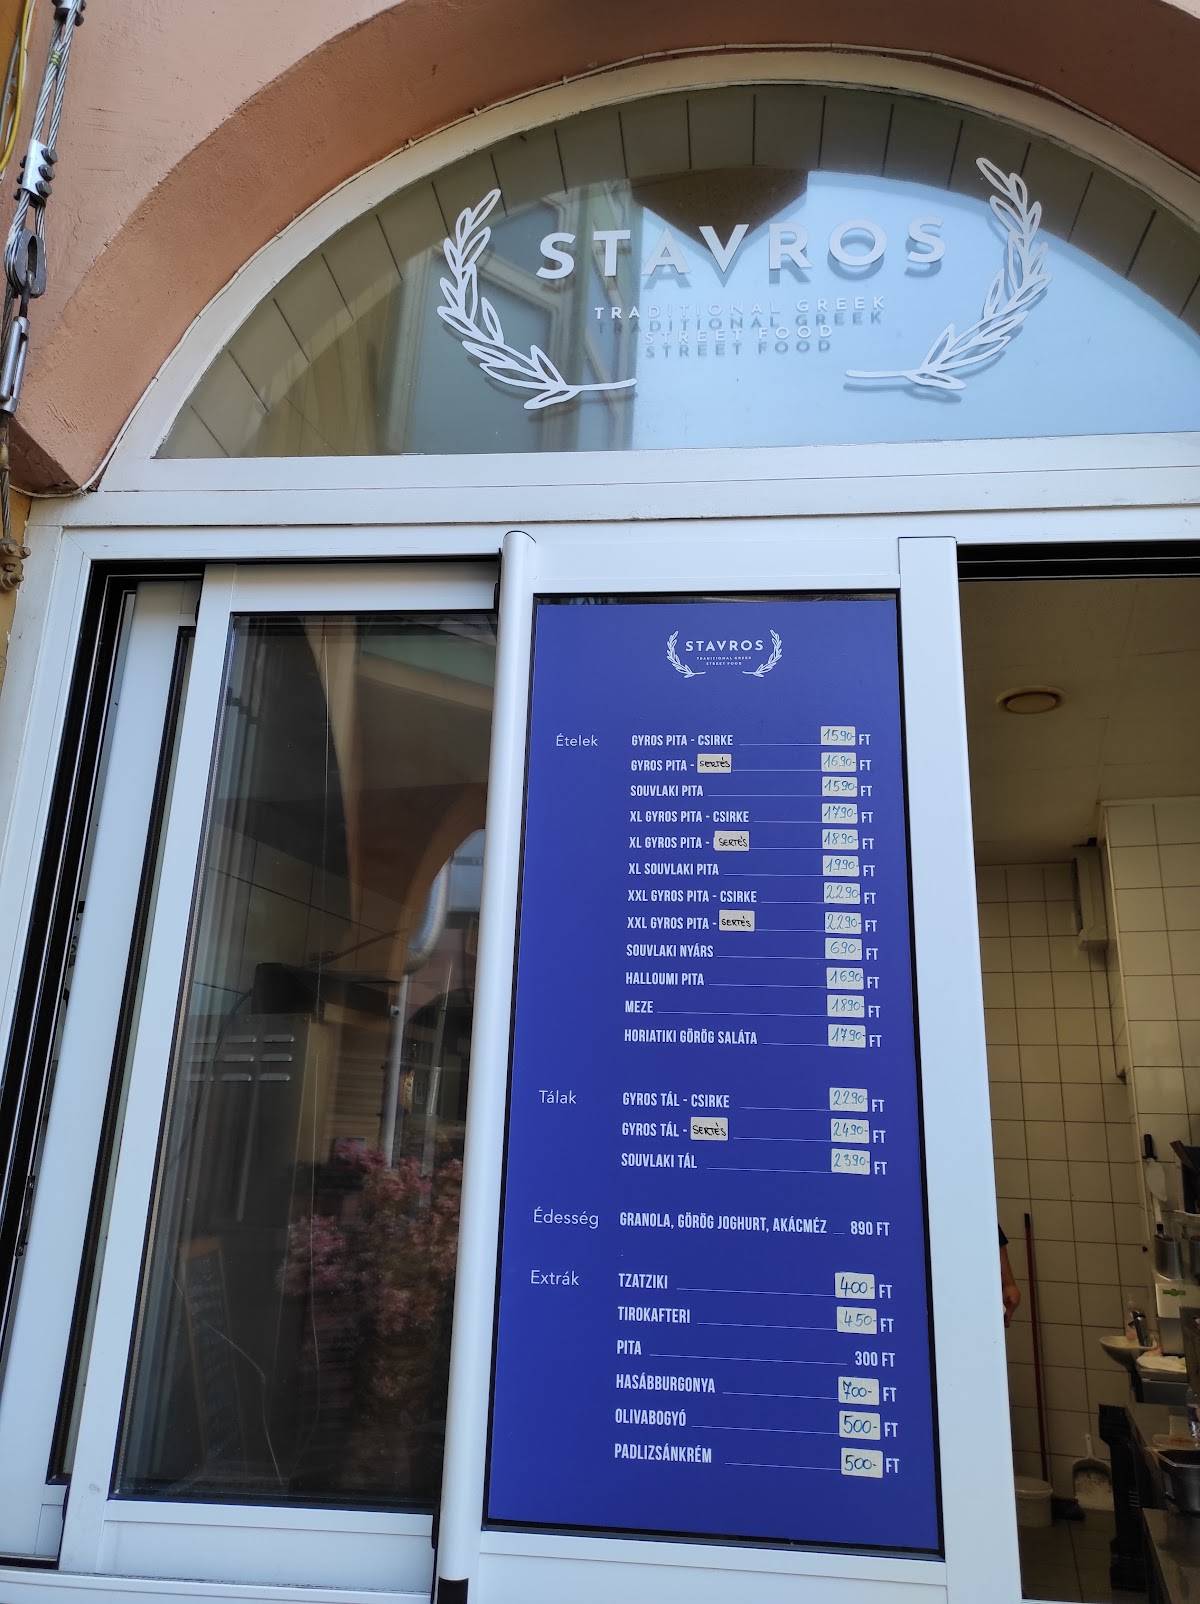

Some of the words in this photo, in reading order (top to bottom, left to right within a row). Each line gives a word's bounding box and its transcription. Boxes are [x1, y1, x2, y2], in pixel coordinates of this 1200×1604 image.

[536, 218, 946, 279] STAVROS
[594, 301, 780, 320] TRADITIONAL
[796, 296, 884, 312] GREEK
[645, 330, 743, 344] STREET
[758, 326, 832, 340] FOOD
[686, 640, 763, 651] STAVROS
[556, 733, 598, 746] Ételek
[632, 735, 661, 746] GYROS
[665, 735, 687, 745] PITA
[698, 735, 733, 745] CSIRKE
[859, 734, 870, 745] FT
[631, 760, 661, 771] GYROS
[665, 760, 687, 771] PITA
[860, 760, 871, 770] FT
[631, 785, 678, 796] SOUVLAKI
[682, 785, 703, 796] PITA
[861, 786, 872, 796] FT
[630, 811, 642, 822] XL
[646, 811, 677, 822] GYROS
[681, 811, 702, 822] PITA
[713, 811, 749, 822] CSIRKE
[862, 812, 873, 823] FT
[629, 837, 642, 848] XL
[645, 837, 677, 848] GYROS
[680, 837, 702, 848] PITA
[863, 838, 874, 849] FT
[628, 863, 641, 874] XL
[644, 863, 693, 875] SOUVLAKI
[697, 864, 719, 875] PITA
[863, 865, 875, 877] FT
[628, 890, 648, 901] XXL
[651, 890, 683, 901] GYROS
[687, 890, 709, 902] PITA
[720, 891, 757, 902] CSIRKE
[864, 893, 876, 904] FT
[627, 917, 647, 928] XXL
[651, 917, 683, 929] GYROS
[687, 917, 709, 929] PITA
[865, 920, 877, 932] FT
[626, 944, 676, 956] SOUVLAKI
[680, 943, 713, 957] NYÁRS
[866, 948, 878, 960] FT
[626, 972, 678, 985] HALLOUMI
[682, 973, 704, 985] PITA
[867, 977, 879, 988] FT
[625, 1001, 653, 1013] MEZE
[868, 1005, 880, 1018] FT
[625, 1029, 676, 1042] HORIATIKI
[680, 1028, 714, 1043] GÖRÖG
[718, 1029, 757, 1044] SALÁTA
[869, 1035, 882, 1047] FT
[539, 1090, 576, 1104] Tálak
[623, 1092, 657, 1106] GYROS
[661, 1091, 679, 1106] TÁL
[691, 1094, 729, 1108] CSIRKE
[872, 1099, 884, 1112] FT
[622, 1123, 656, 1136] GYROS
[660, 1121, 679, 1137] TÁL
[873, 1130, 886, 1143] FT
[621, 1153, 674, 1167] SOUVLAKI
[678, 1153, 697, 1168] TÁL
[874, 1161, 887, 1175] FT
[534, 1206, 598, 1229] Édesség
[620, 1212, 674, 1229] GRANOLA,
[678, 1212, 714, 1229] GÖRÖG
[717, 1216, 769, 1232] JOGHURT,
[773, 1216, 827, 1233] AKÁCMÉZ
[851, 1221, 873, 1235] 890
[877, 1222, 890, 1236] FT
[531, 1270, 579, 1285] Extrák
[619, 1273, 667, 1289] TZATZIKI
[879, 1285, 892, 1298] FT
[618, 1306, 690, 1323] TIROKAFTERI
[881, 1318, 894, 1332] FT
[617, 1340, 641, 1355] PITA
[855, 1351, 878, 1366] 300
[882, 1352, 895, 1367] FT
[616, 1373, 715, 1393] HASÁBBURGONYA
[883, 1387, 896, 1402] FT
[615, 1409, 686, 1426] OLIVABOGYÓ
[884, 1422, 898, 1437] FT
[615, 1443, 711, 1463] PADLIZSÁNKRÉM
[886, 1458, 899, 1473] FT
